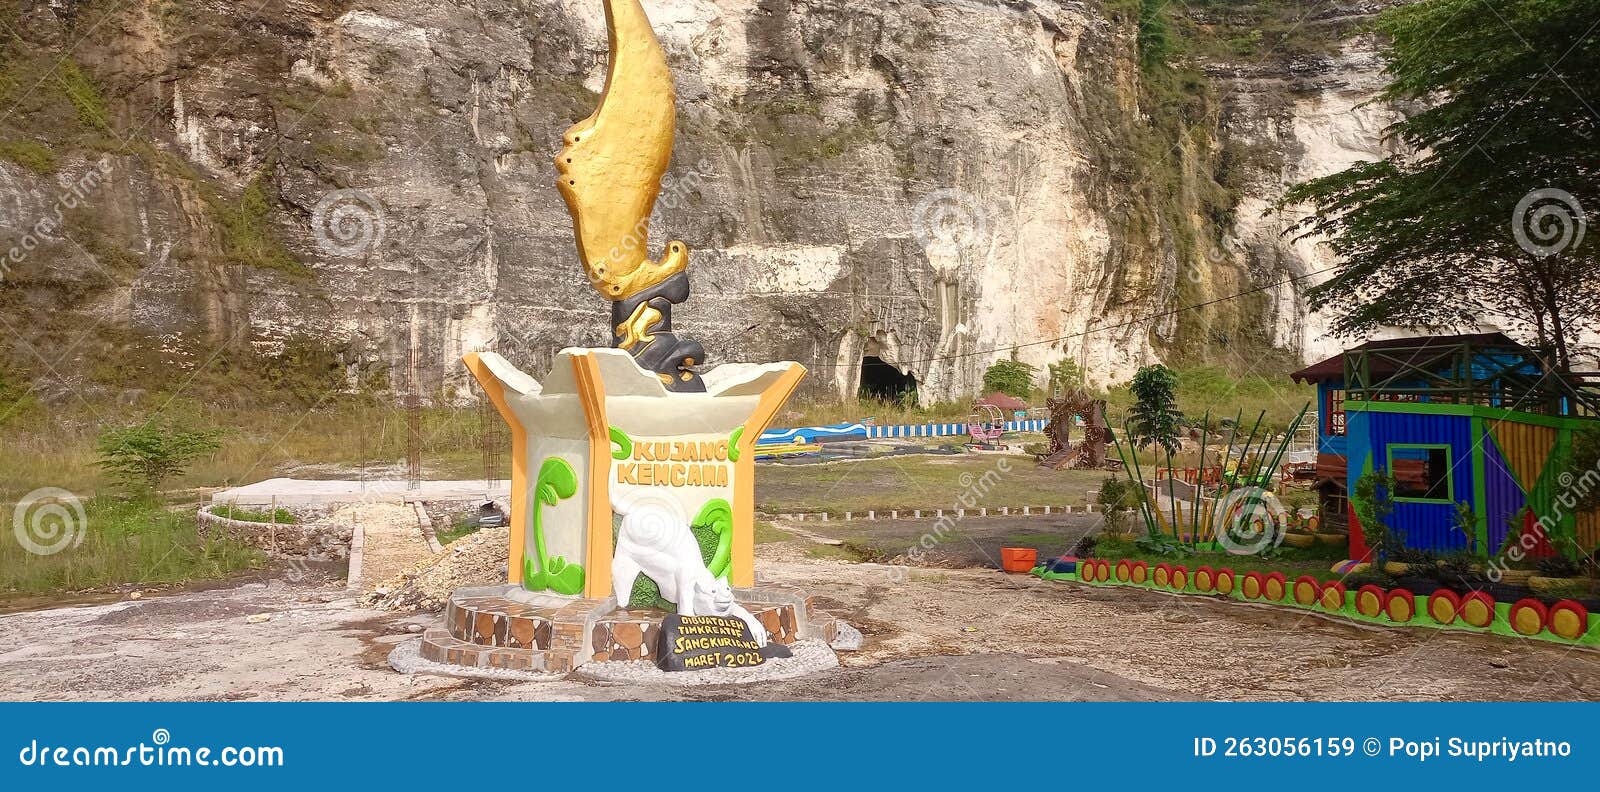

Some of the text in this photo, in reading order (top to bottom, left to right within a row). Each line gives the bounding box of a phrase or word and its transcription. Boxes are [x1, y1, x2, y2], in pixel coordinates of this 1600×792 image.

[633, 440, 728, 462] KUJANG
[617, 463, 728, 488] KENCANA
[674, 636, 759, 654] SANGKURIANG
[684, 652, 763, 668] MARET 2022
